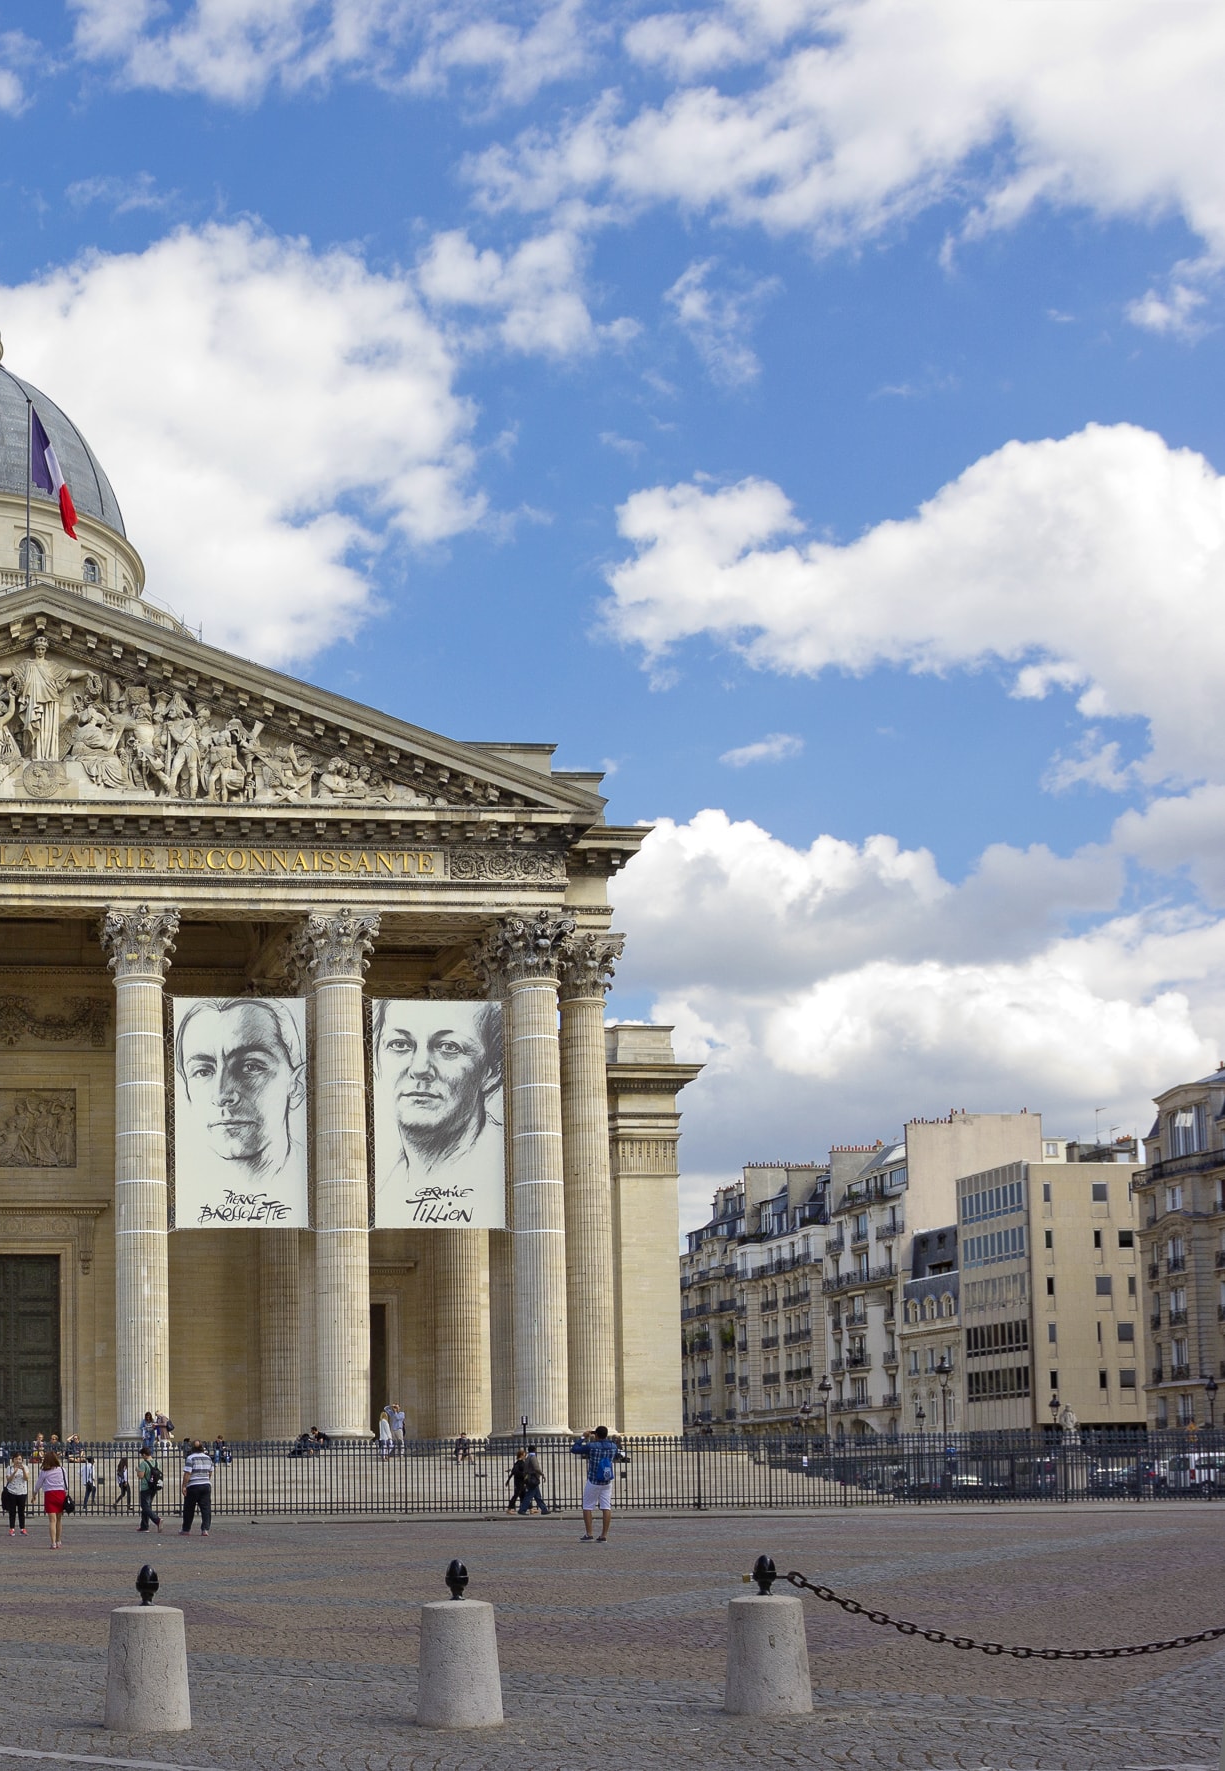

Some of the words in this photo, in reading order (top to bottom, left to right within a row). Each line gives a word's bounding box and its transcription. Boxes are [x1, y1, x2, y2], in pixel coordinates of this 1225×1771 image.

[47, 845, 156, 870] PATRIE
[166, 848, 435, 874] RECONNAISSANTE
[197, 1201, 292, 1225] BROSSOLETTE
